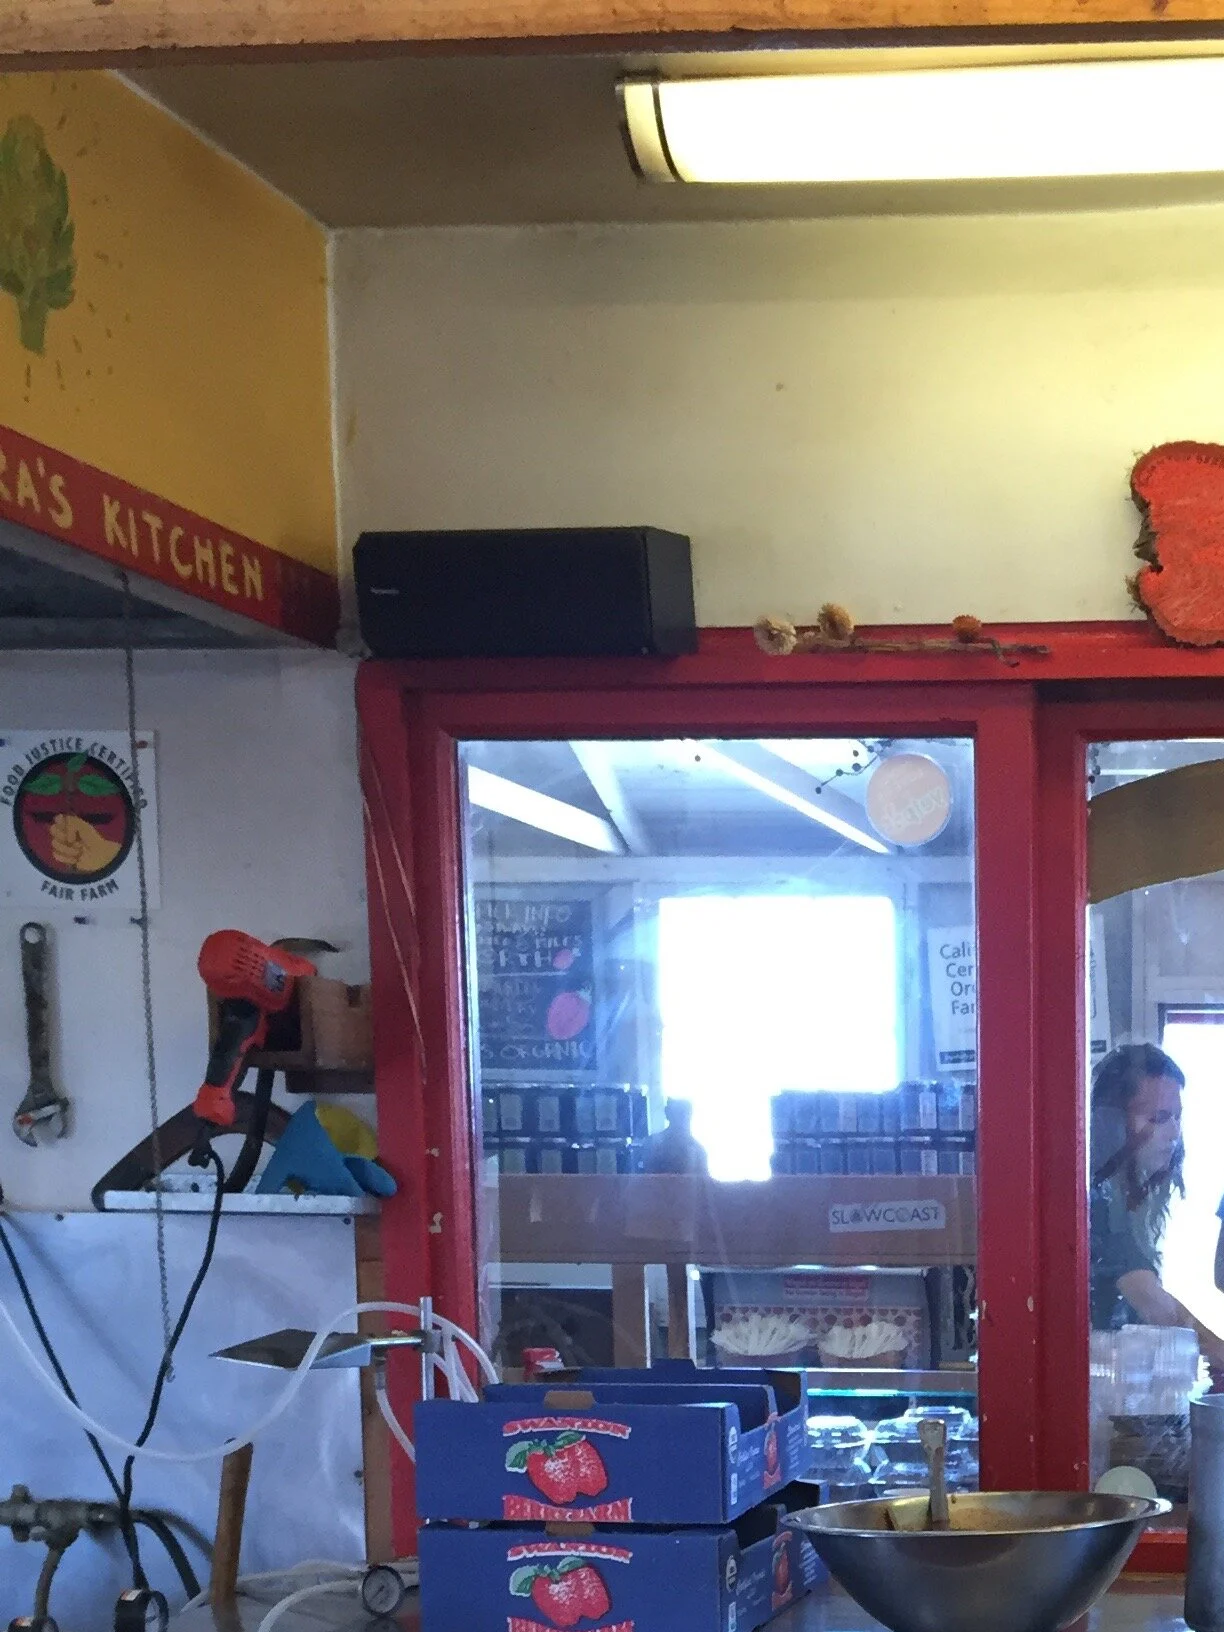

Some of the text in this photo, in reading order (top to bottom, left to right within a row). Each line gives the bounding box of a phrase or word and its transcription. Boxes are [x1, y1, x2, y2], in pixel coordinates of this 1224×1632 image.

[103, 494, 264, 601] KITCHEN
[1, 764, 26, 806] FOOD
[24, 736, 84, 766] JUSTICE
[40, 877, 120, 901] FAIR FARM
